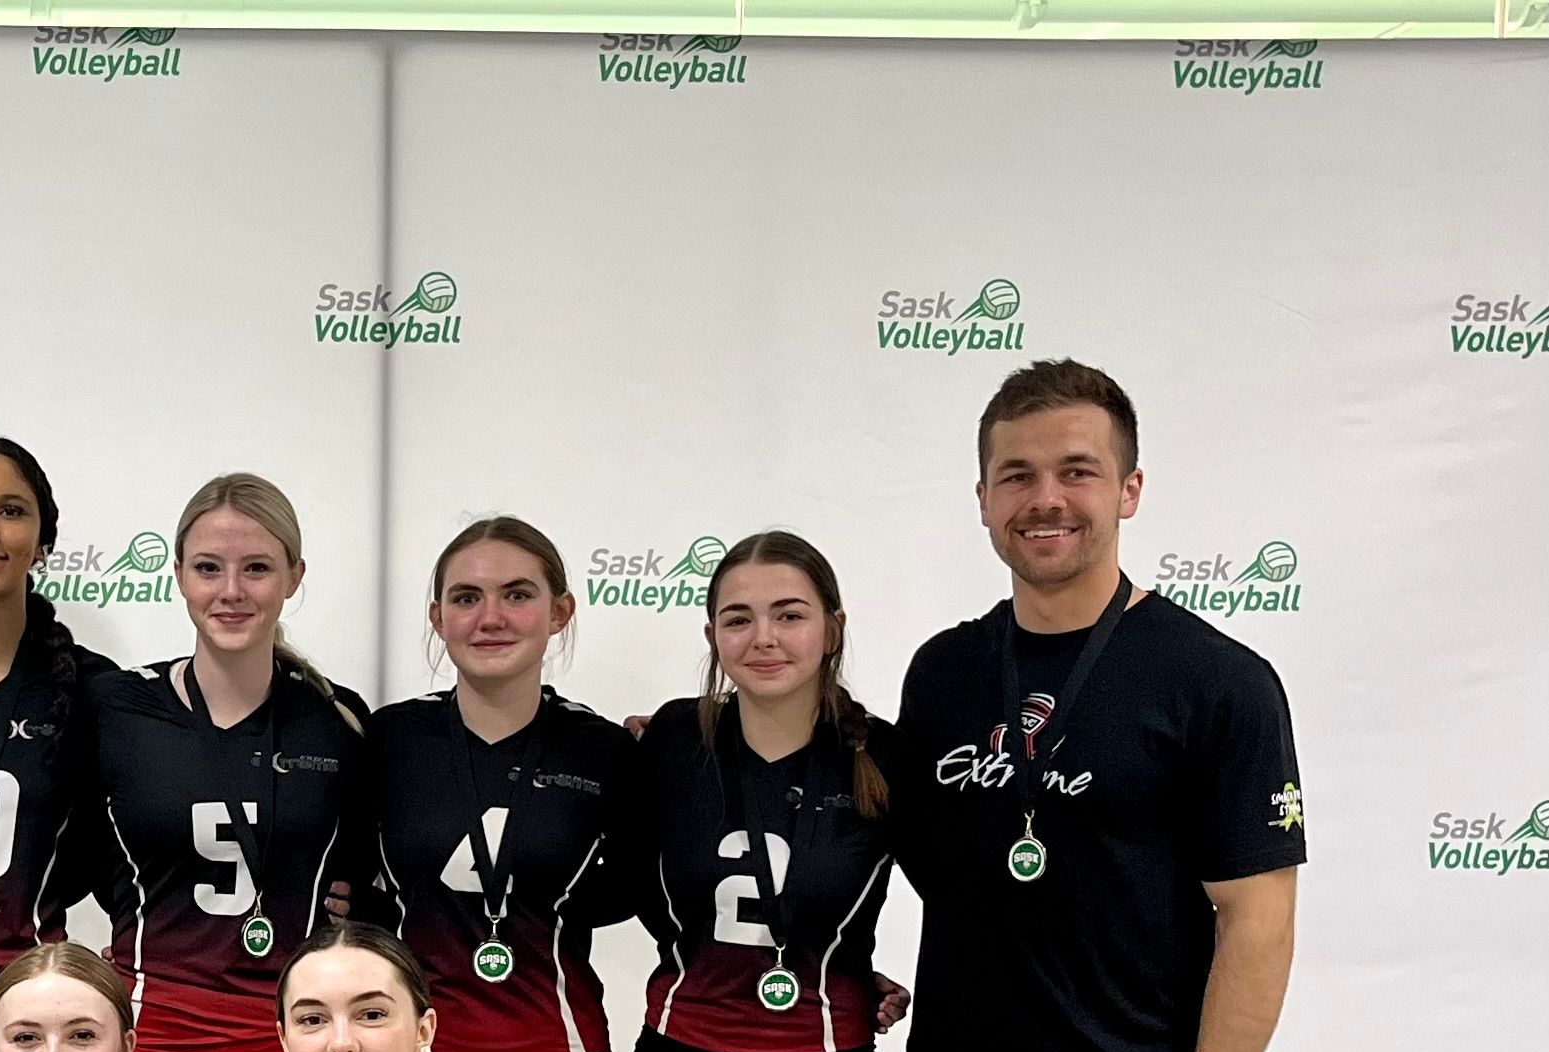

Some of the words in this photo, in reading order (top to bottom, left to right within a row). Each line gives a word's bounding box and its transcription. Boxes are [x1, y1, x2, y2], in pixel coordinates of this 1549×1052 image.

[33, 47, 181, 82] Volleyball
[599, 54, 747, 90] Volleyball
[1174, 61, 1324, 96] Volleyball
[315, 283, 391, 313] Sask
[878, 290, 955, 320] Sask
[1451, 294, 1531, 322] Sask
[314, 315, 461, 349] Volleyball
[877, 321, 1024, 356] Volleyball
[48, 544, 104, 572] ask
[587, 548, 664, 576] Sask
[1155, 553, 1232, 581] Sask
[1429, 812, 1507, 839] Sask
[191, 802, 258, 916] 5
[440, 807, 514, 918] 4
[713, 829, 791, 947] 2
